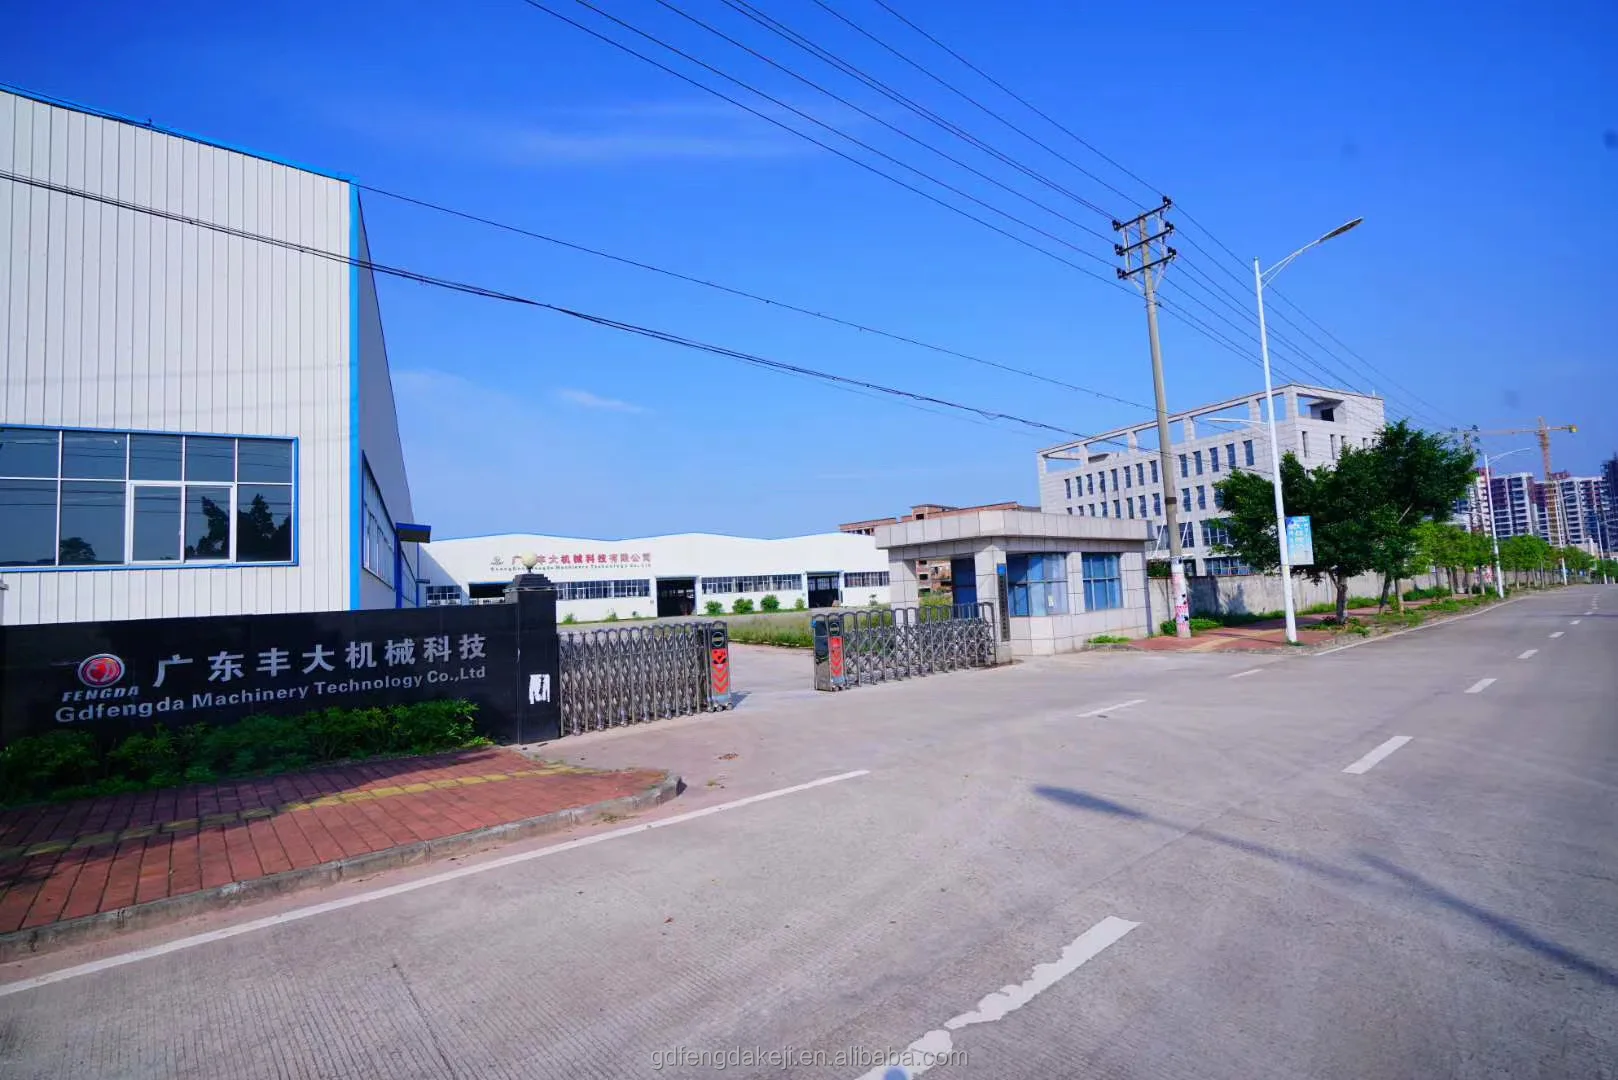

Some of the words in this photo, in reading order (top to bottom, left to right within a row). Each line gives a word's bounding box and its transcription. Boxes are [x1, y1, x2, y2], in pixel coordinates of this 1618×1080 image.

[153, 633, 487, 687] 广东丰大机械科技
[55, 696, 185, 723] Gdfengda
[192, 685, 309, 709] Machinery
[313, 674, 423, 695] Technology
[427, 666, 486, 683] Co.,Ltd
[62, 686, 140, 702] FENGDA
